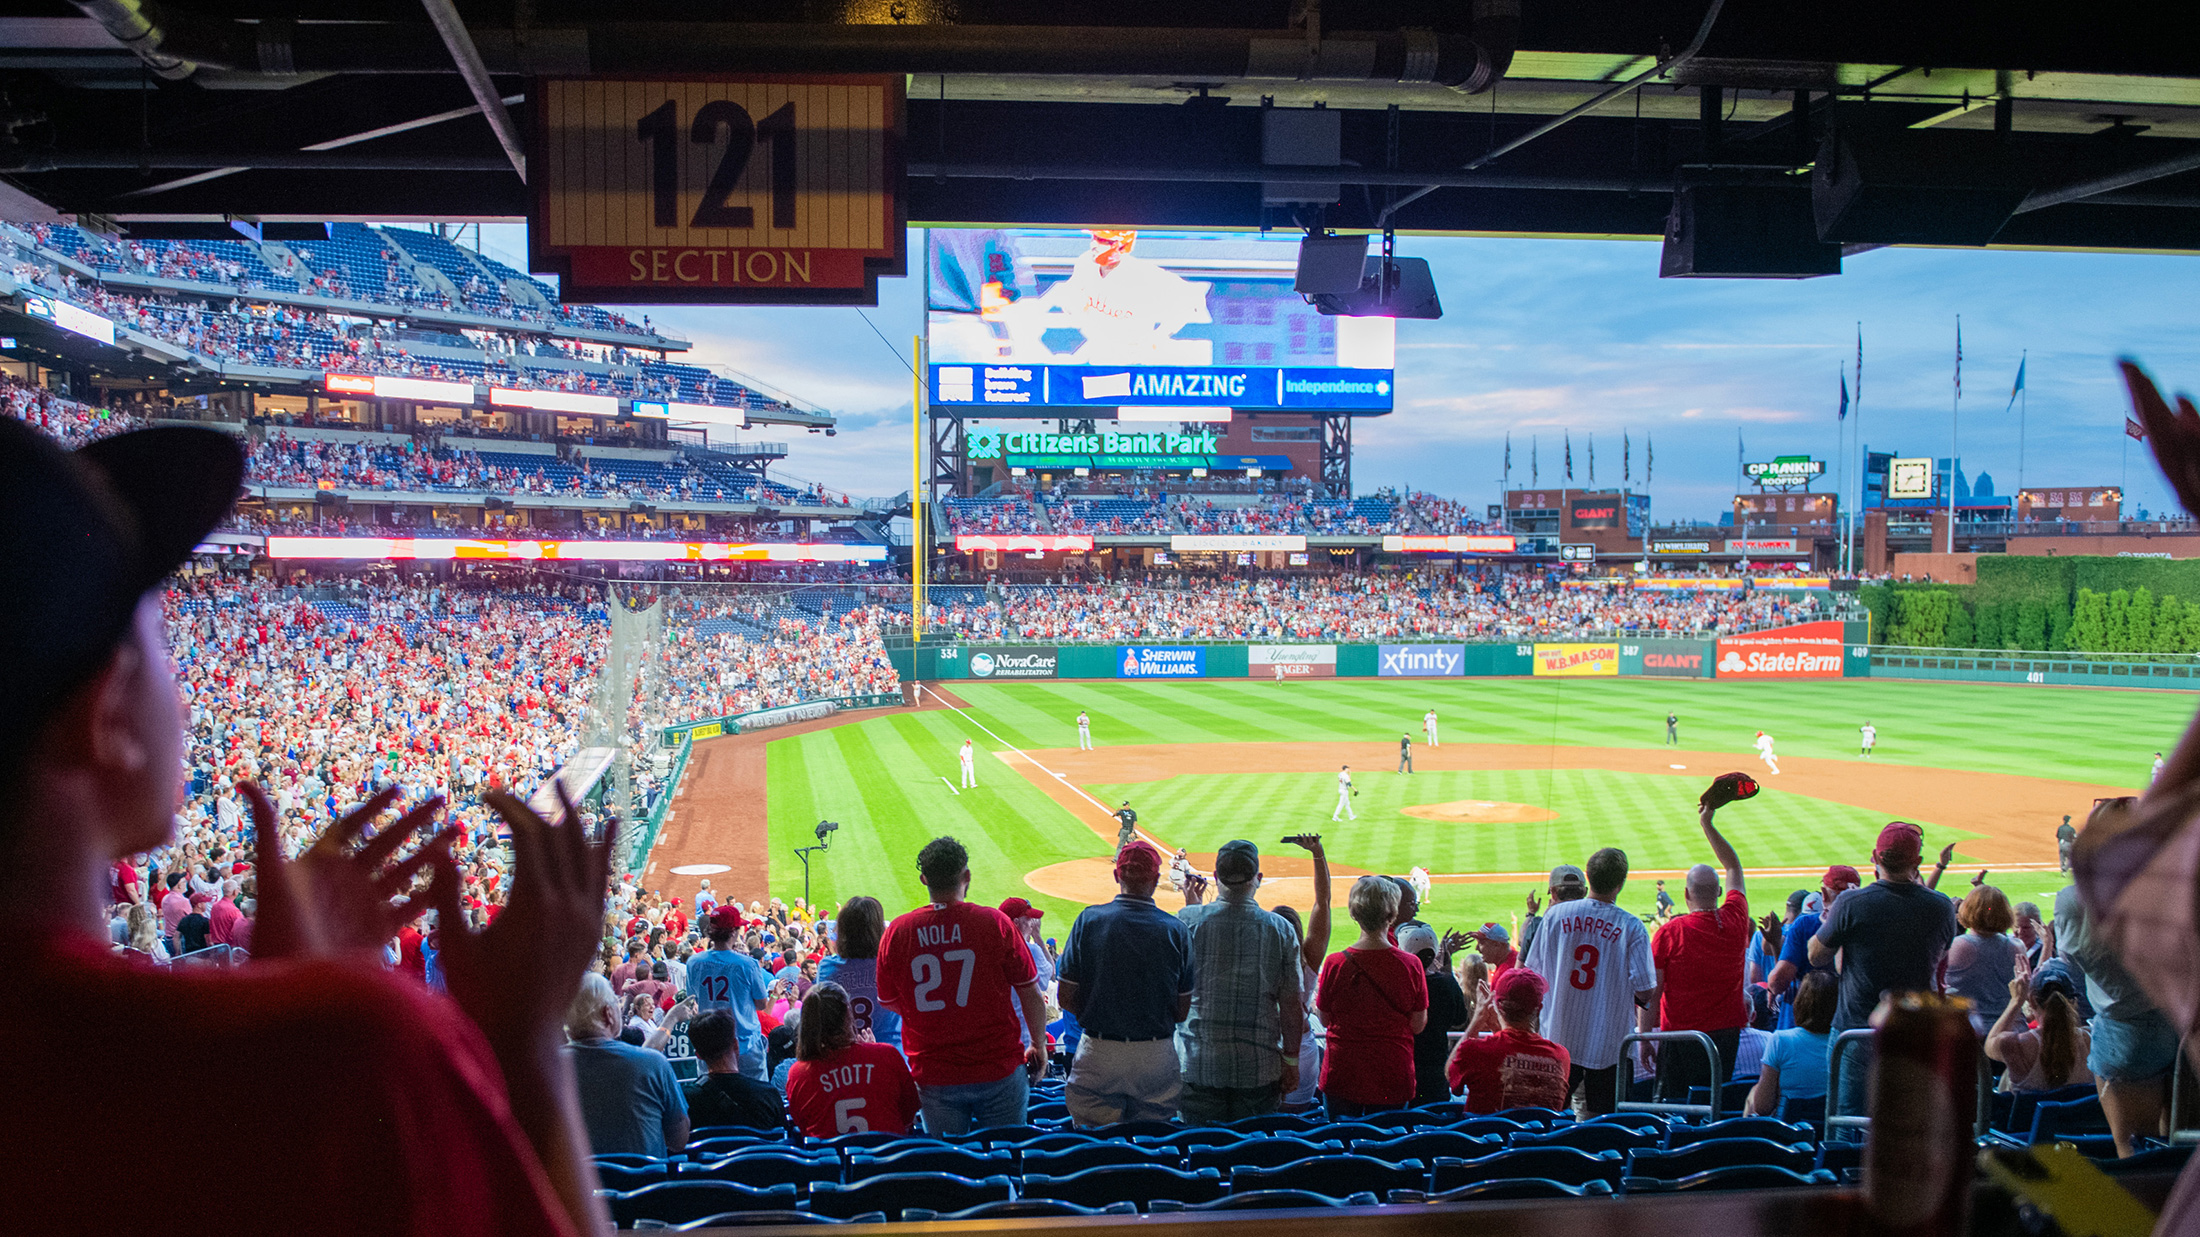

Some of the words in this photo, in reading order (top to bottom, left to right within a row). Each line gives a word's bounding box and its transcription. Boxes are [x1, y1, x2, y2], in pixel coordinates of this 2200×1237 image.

[637, 100, 796, 229] 121
[629, 250, 811, 283] SECTION
[1133, 374, 1246, 397] AMAZING
[1286, 379, 1374, 396] Independence
[1005, 431, 1099, 454] Citizens
[1103, 431, 1163, 454] Bank
[1166, 431, 1218, 454] Park
[1748, 463, 1768, 475] CP
[1769, 461, 1820, 474] RANKIN
[1761, 477, 1807, 486] ROOFTOP
[1574, 508, 1615, 518] GIANT
[940, 648, 958, 659] 334
[995, 654, 1056, 668] NovaCare
[1140, 648, 1196, 661] SHERWIN
[1265, 648, 1320, 663] Yuengling
[1384, 647, 1460, 675] xfinity
[1516, 645, 1533, 656] 374
[1644, 654, 1702, 668] GIANT
[1140, 662, 1198, 675] WILLIAMS.
[2026, 671, 2044, 683] 401
[917, 923, 962, 948] NOLA
[1562, 916, 1622, 944] HARPER
[1570, 944, 1599, 990] 3
[702, 976, 729, 1001] 12
[911, 948, 976, 1012] 27
[667, 1035, 689, 1057] 26
[820, 1063, 875, 1093] STOTT
[834, 1097, 869, 1134] 5
